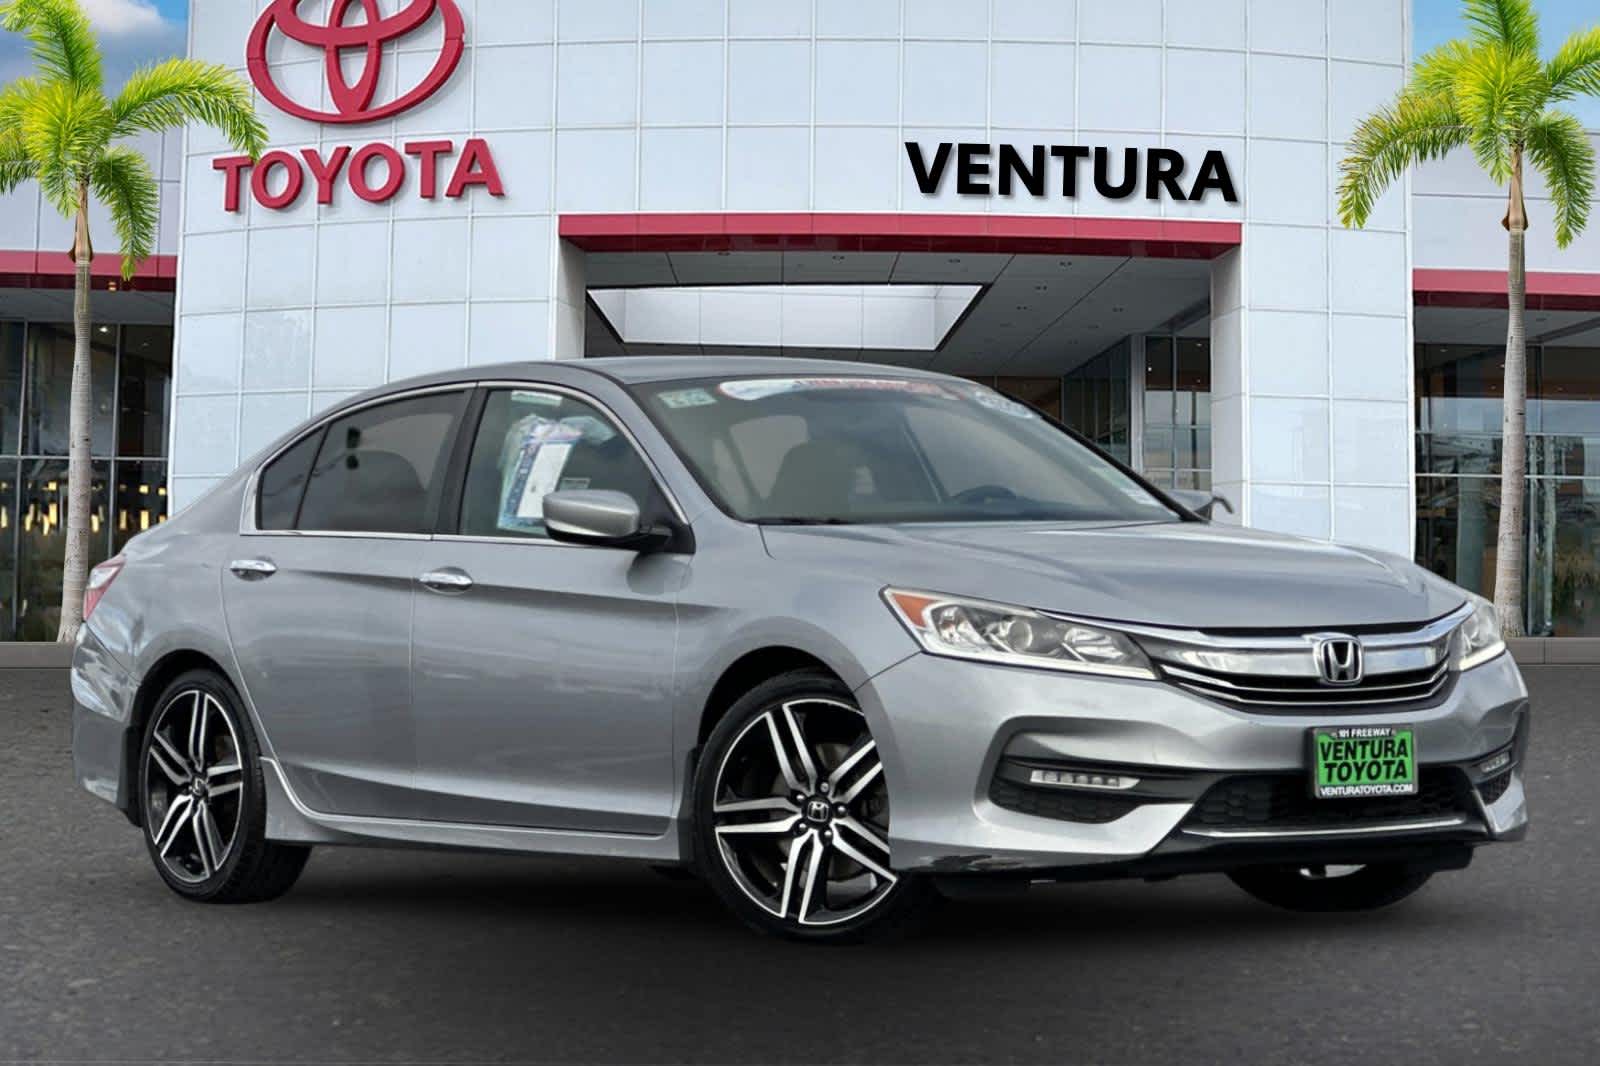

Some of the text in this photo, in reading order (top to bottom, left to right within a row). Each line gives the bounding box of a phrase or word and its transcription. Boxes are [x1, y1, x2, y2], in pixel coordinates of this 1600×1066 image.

[213, 138, 505, 212] TOYOTA
[905, 142, 1238, 202] VENTURA
[1351, 728, 1391, 737] FREEWAY
[1320, 738, 1408, 761] VENTURA
[1324, 760, 1408, 782] TOYOTA
[1320, 784, 1413, 796] VENTURATOYOTA.COM
